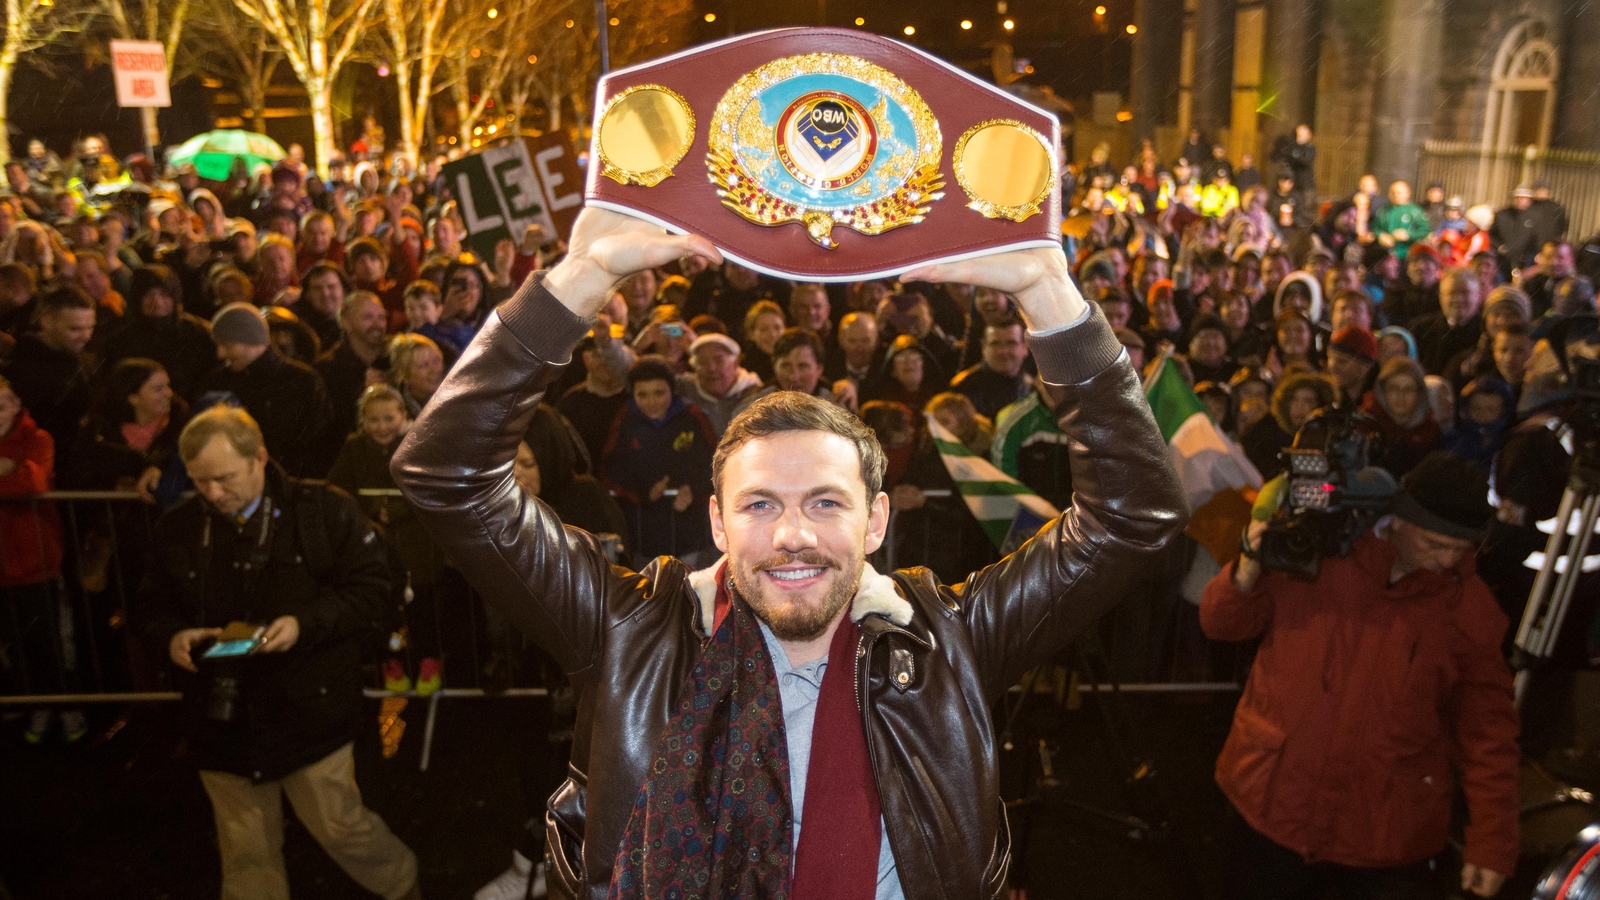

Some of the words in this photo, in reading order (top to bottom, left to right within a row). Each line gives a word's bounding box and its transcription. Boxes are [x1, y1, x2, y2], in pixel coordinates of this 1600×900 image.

[812, 109, 846, 124] WBO
[778, 144, 831, 188] CAMPION
[839, 154, 873, 185] WORLD
[457, 146, 582, 234] LEE
